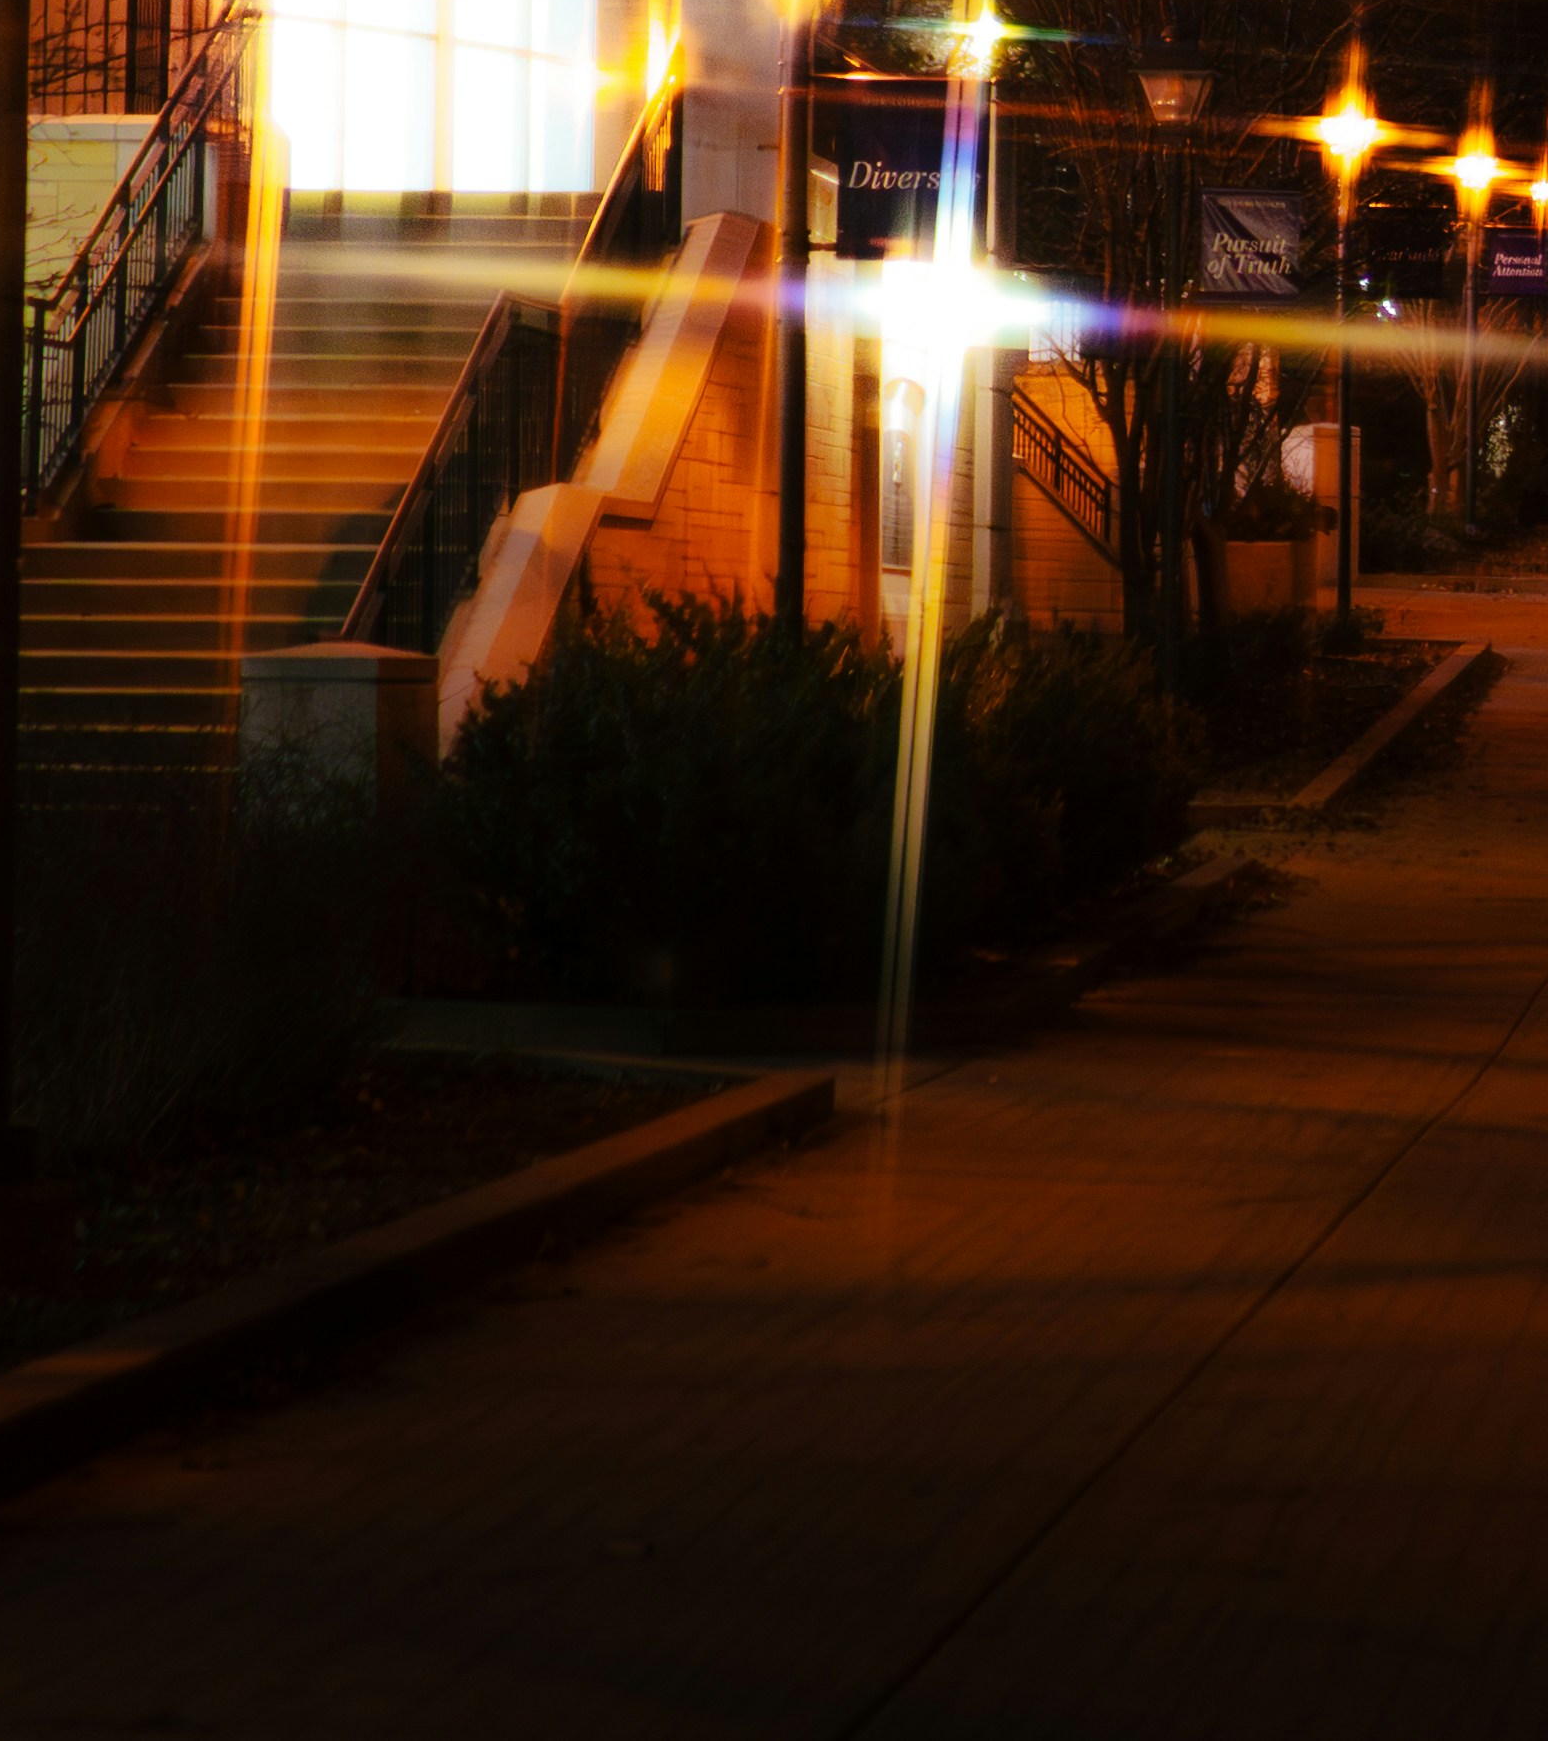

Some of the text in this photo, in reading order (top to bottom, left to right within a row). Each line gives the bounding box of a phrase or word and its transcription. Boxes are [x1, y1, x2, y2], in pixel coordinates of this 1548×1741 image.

[848, 160, 982, 192] Divers
[1211, 231, 1287, 255] Pursuit
[1206, 252, 1293, 280] of Truth
[1492, 265, 1545, 277] Attention
[1493, 252, 1543, 266] Personal
